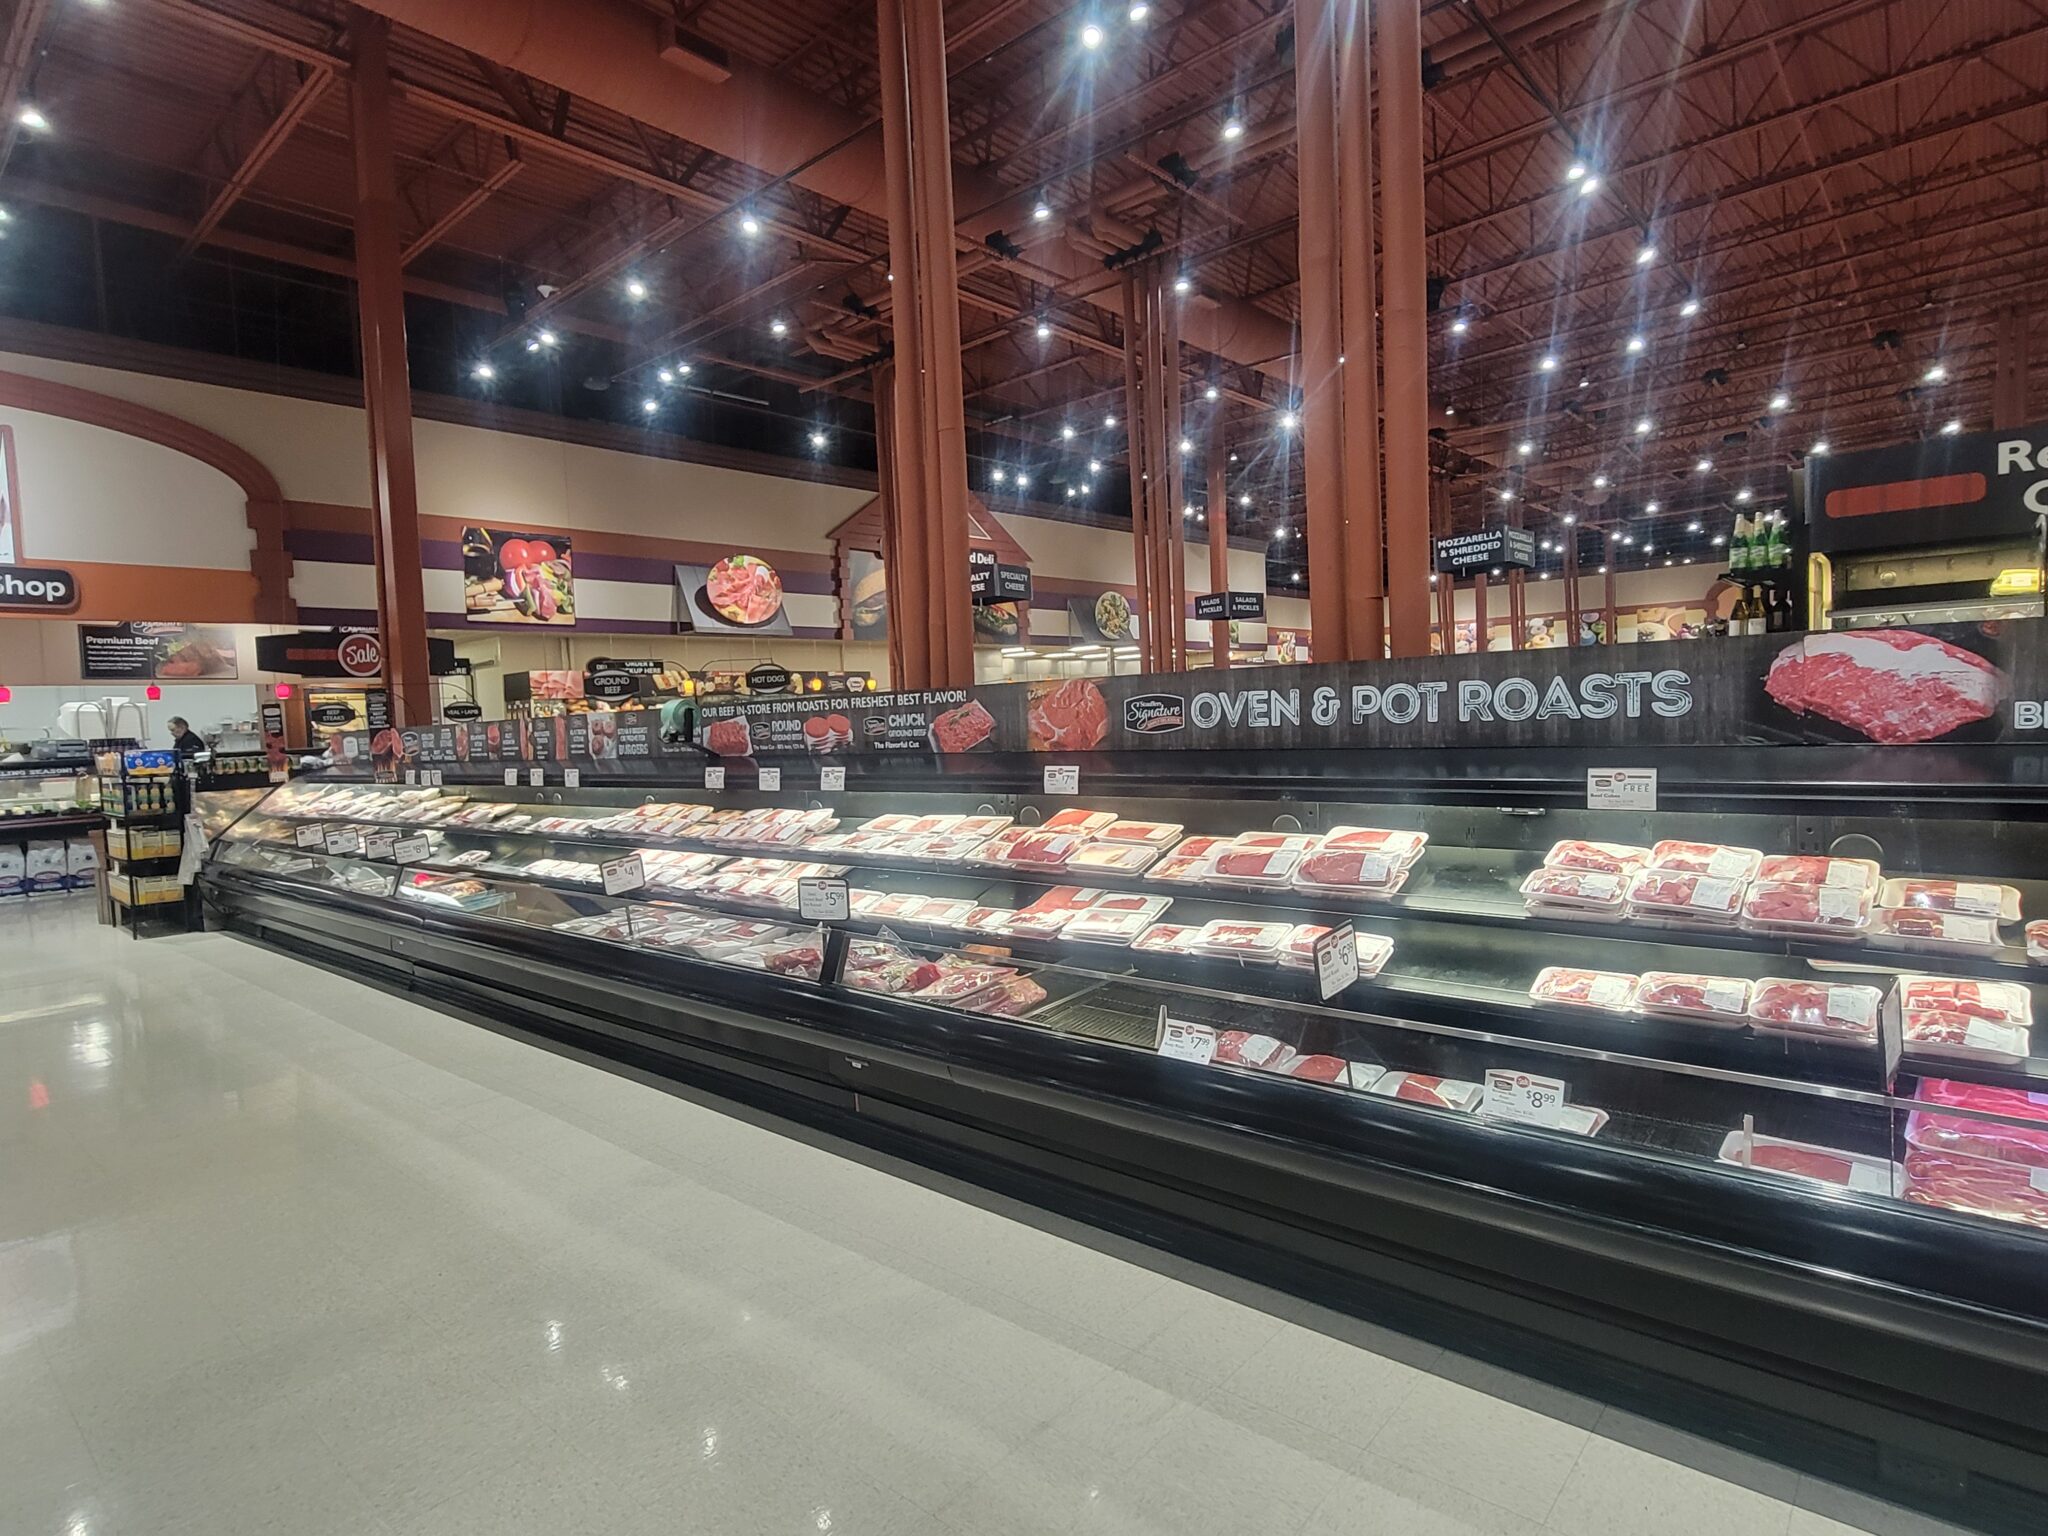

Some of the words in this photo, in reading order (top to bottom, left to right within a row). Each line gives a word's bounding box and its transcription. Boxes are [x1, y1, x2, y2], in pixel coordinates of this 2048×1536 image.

[1438, 530, 1502, 549] MOZZARELLA
[1440, 550, 1447, 558] &
[1449, 541, 1501, 556] SHREDDED
[977, 553, 994, 564] Deli
[1452, 552, 1489, 565] CHEESE
[1000, 571, 1028, 582] SPECIALTY
[0, 574, 65, 601] hop
[1005, 582, 1025, 591] CHEESE
[1201, 598, 1220, 606] SALADS
[1203, 606, 1223, 614] PICKLES
[86, 636, 133, 645] Premium
[135, 636, 159, 645] Beef
[346, 643, 379, 665] Sale
[594, 677, 630, 686] GROUND
[751, 676, 768, 684] HOT
[769, 674, 786, 684] DOGS
[604, 685, 621, 694] BEEF
[702, 708, 717, 717] OUR
[718, 706, 735, 716] BEEF
[737, 703, 771, 715] IN-STORE
[772, 702, 795, 713] FROM
[797, 699, 829, 711] ROASTS
[831, 698, 849, 710] FOR
[851, 695, 895, 708] FRESHEST
[897, 693, 920, 706] BEST
[923, 690, 967, 704] FLAVOR!
[1190, 688, 1300, 729] OVEN
[1311, 686, 1340, 726] &
[1352, 682, 1447, 725] POT
[1458, 670, 1693, 722] ROASTS
[889, 713, 925, 727] CHUCK
[1127, 702, 1181, 729] Signature
[2014, 701, 2048, 729] B
[771, 719, 801, 731] ROUND
[618, 743, 649, 755] BURGERS
[1623, 784, 1649, 793] FREE
